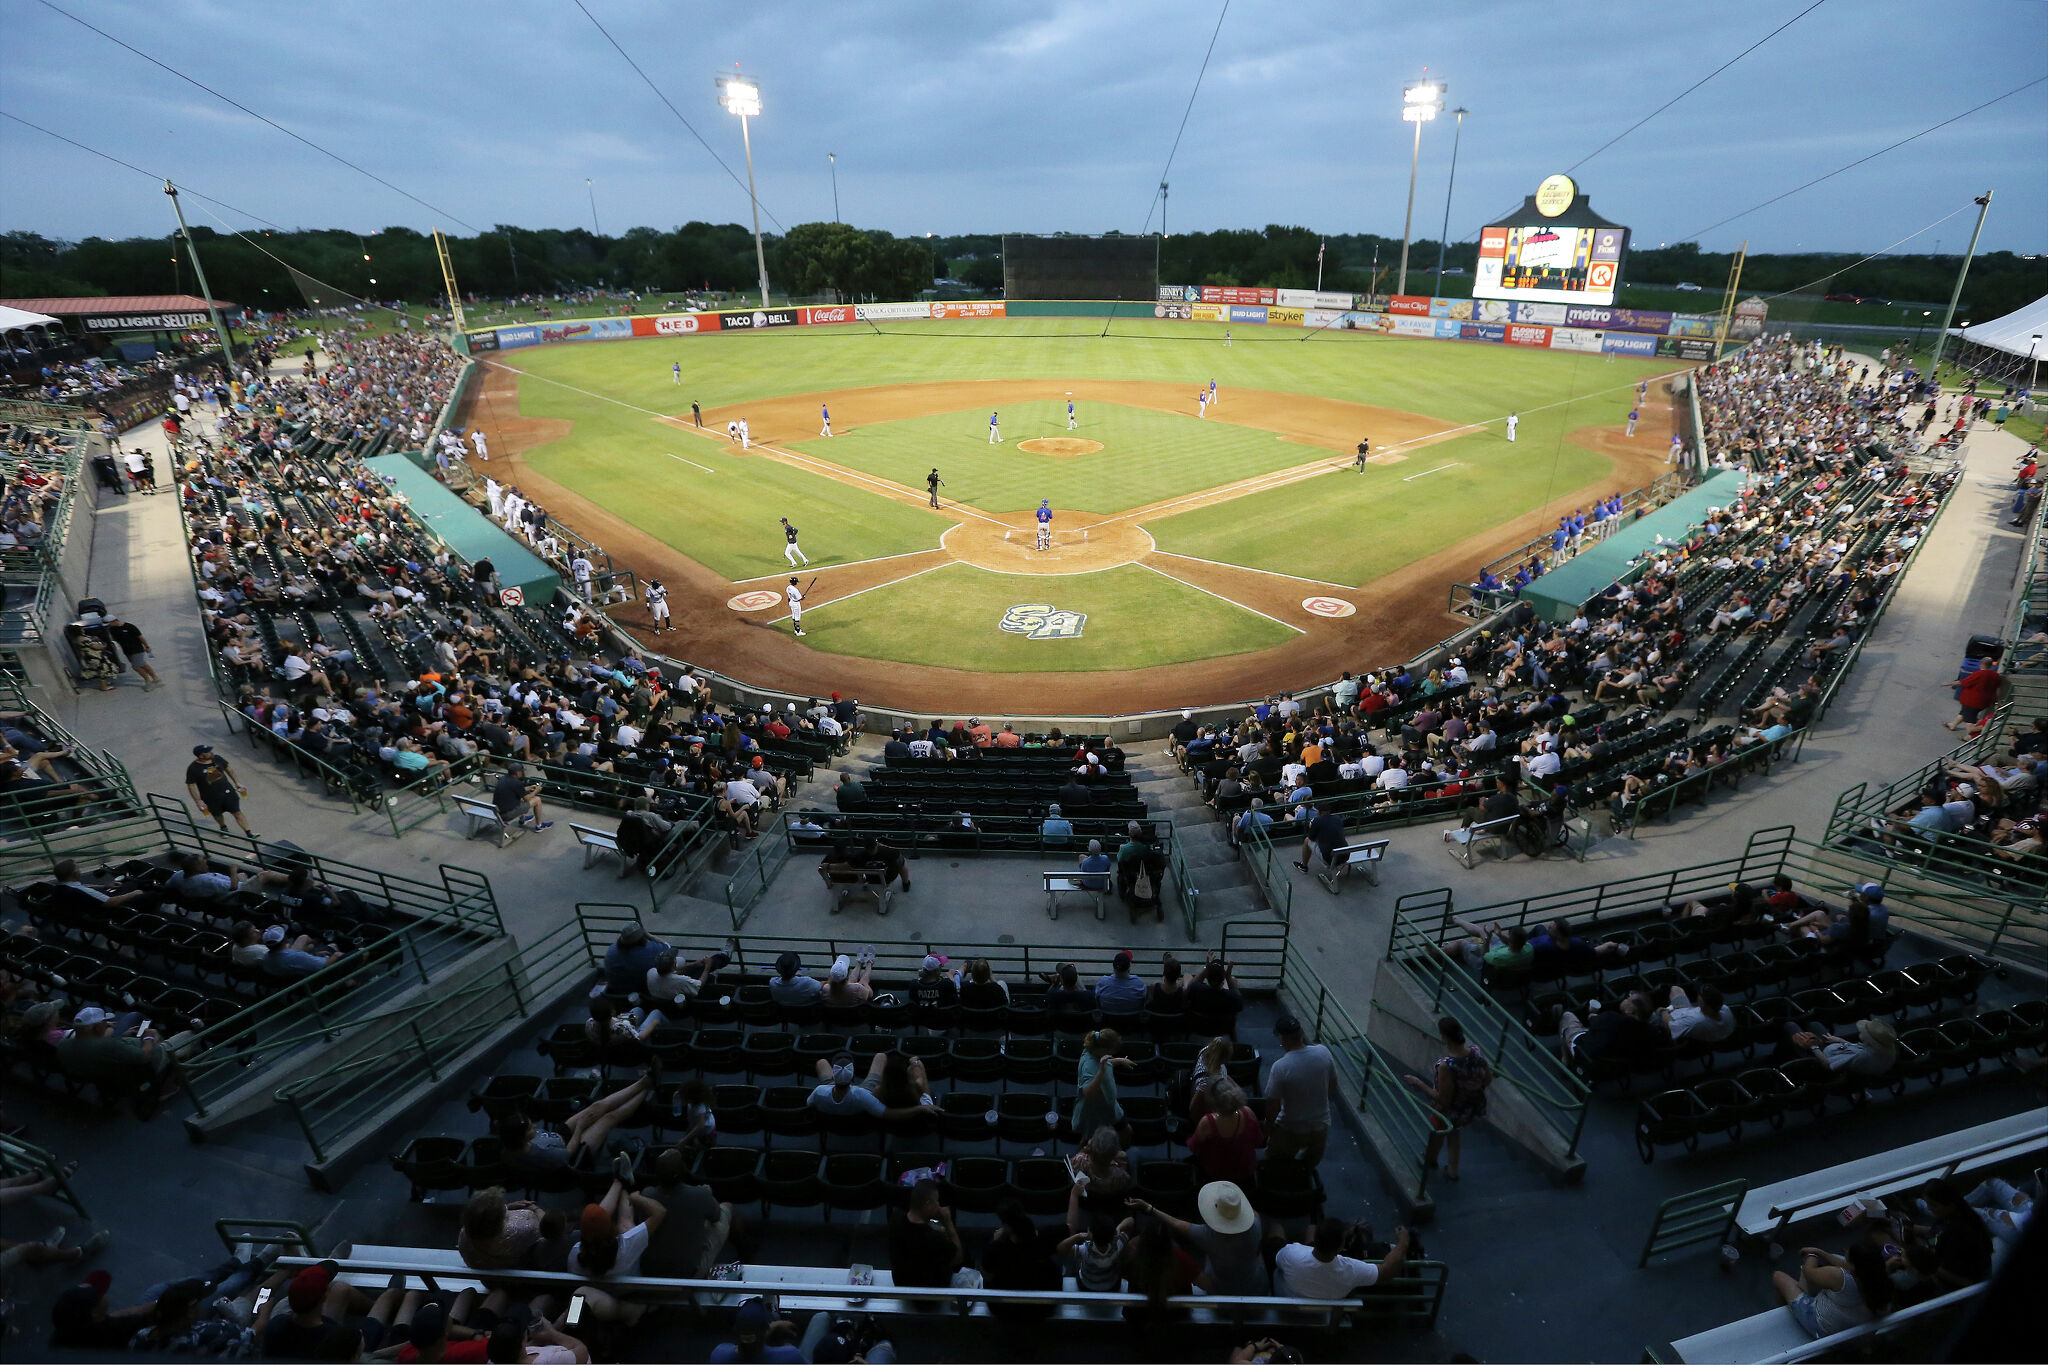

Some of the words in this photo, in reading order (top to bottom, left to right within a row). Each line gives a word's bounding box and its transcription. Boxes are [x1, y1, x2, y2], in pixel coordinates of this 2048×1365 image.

[1159, 287, 1184, 297] HENRY'S
[1390, 300, 1410, 309] Great
[1411, 301, 1428, 311] Clips
[725, 316, 751, 327] TACO
[768, 313, 790, 324] BELL
[815, 308, 846, 323] Coca-Cola
[1232, 310, 1245, 318] BUD
[1268, 310, 1305, 322] stryker
[1569, 308, 1611, 321] metro
[87, 318, 119, 329] BUD
[120, 316, 161, 328] LIGHT
[161, 313, 208, 328] SELTZER
[1605, 338, 1625, 348] BUD
[1625, 340, 1653, 350] LIGHT
[917, 989, 940, 999] PIAZZA
